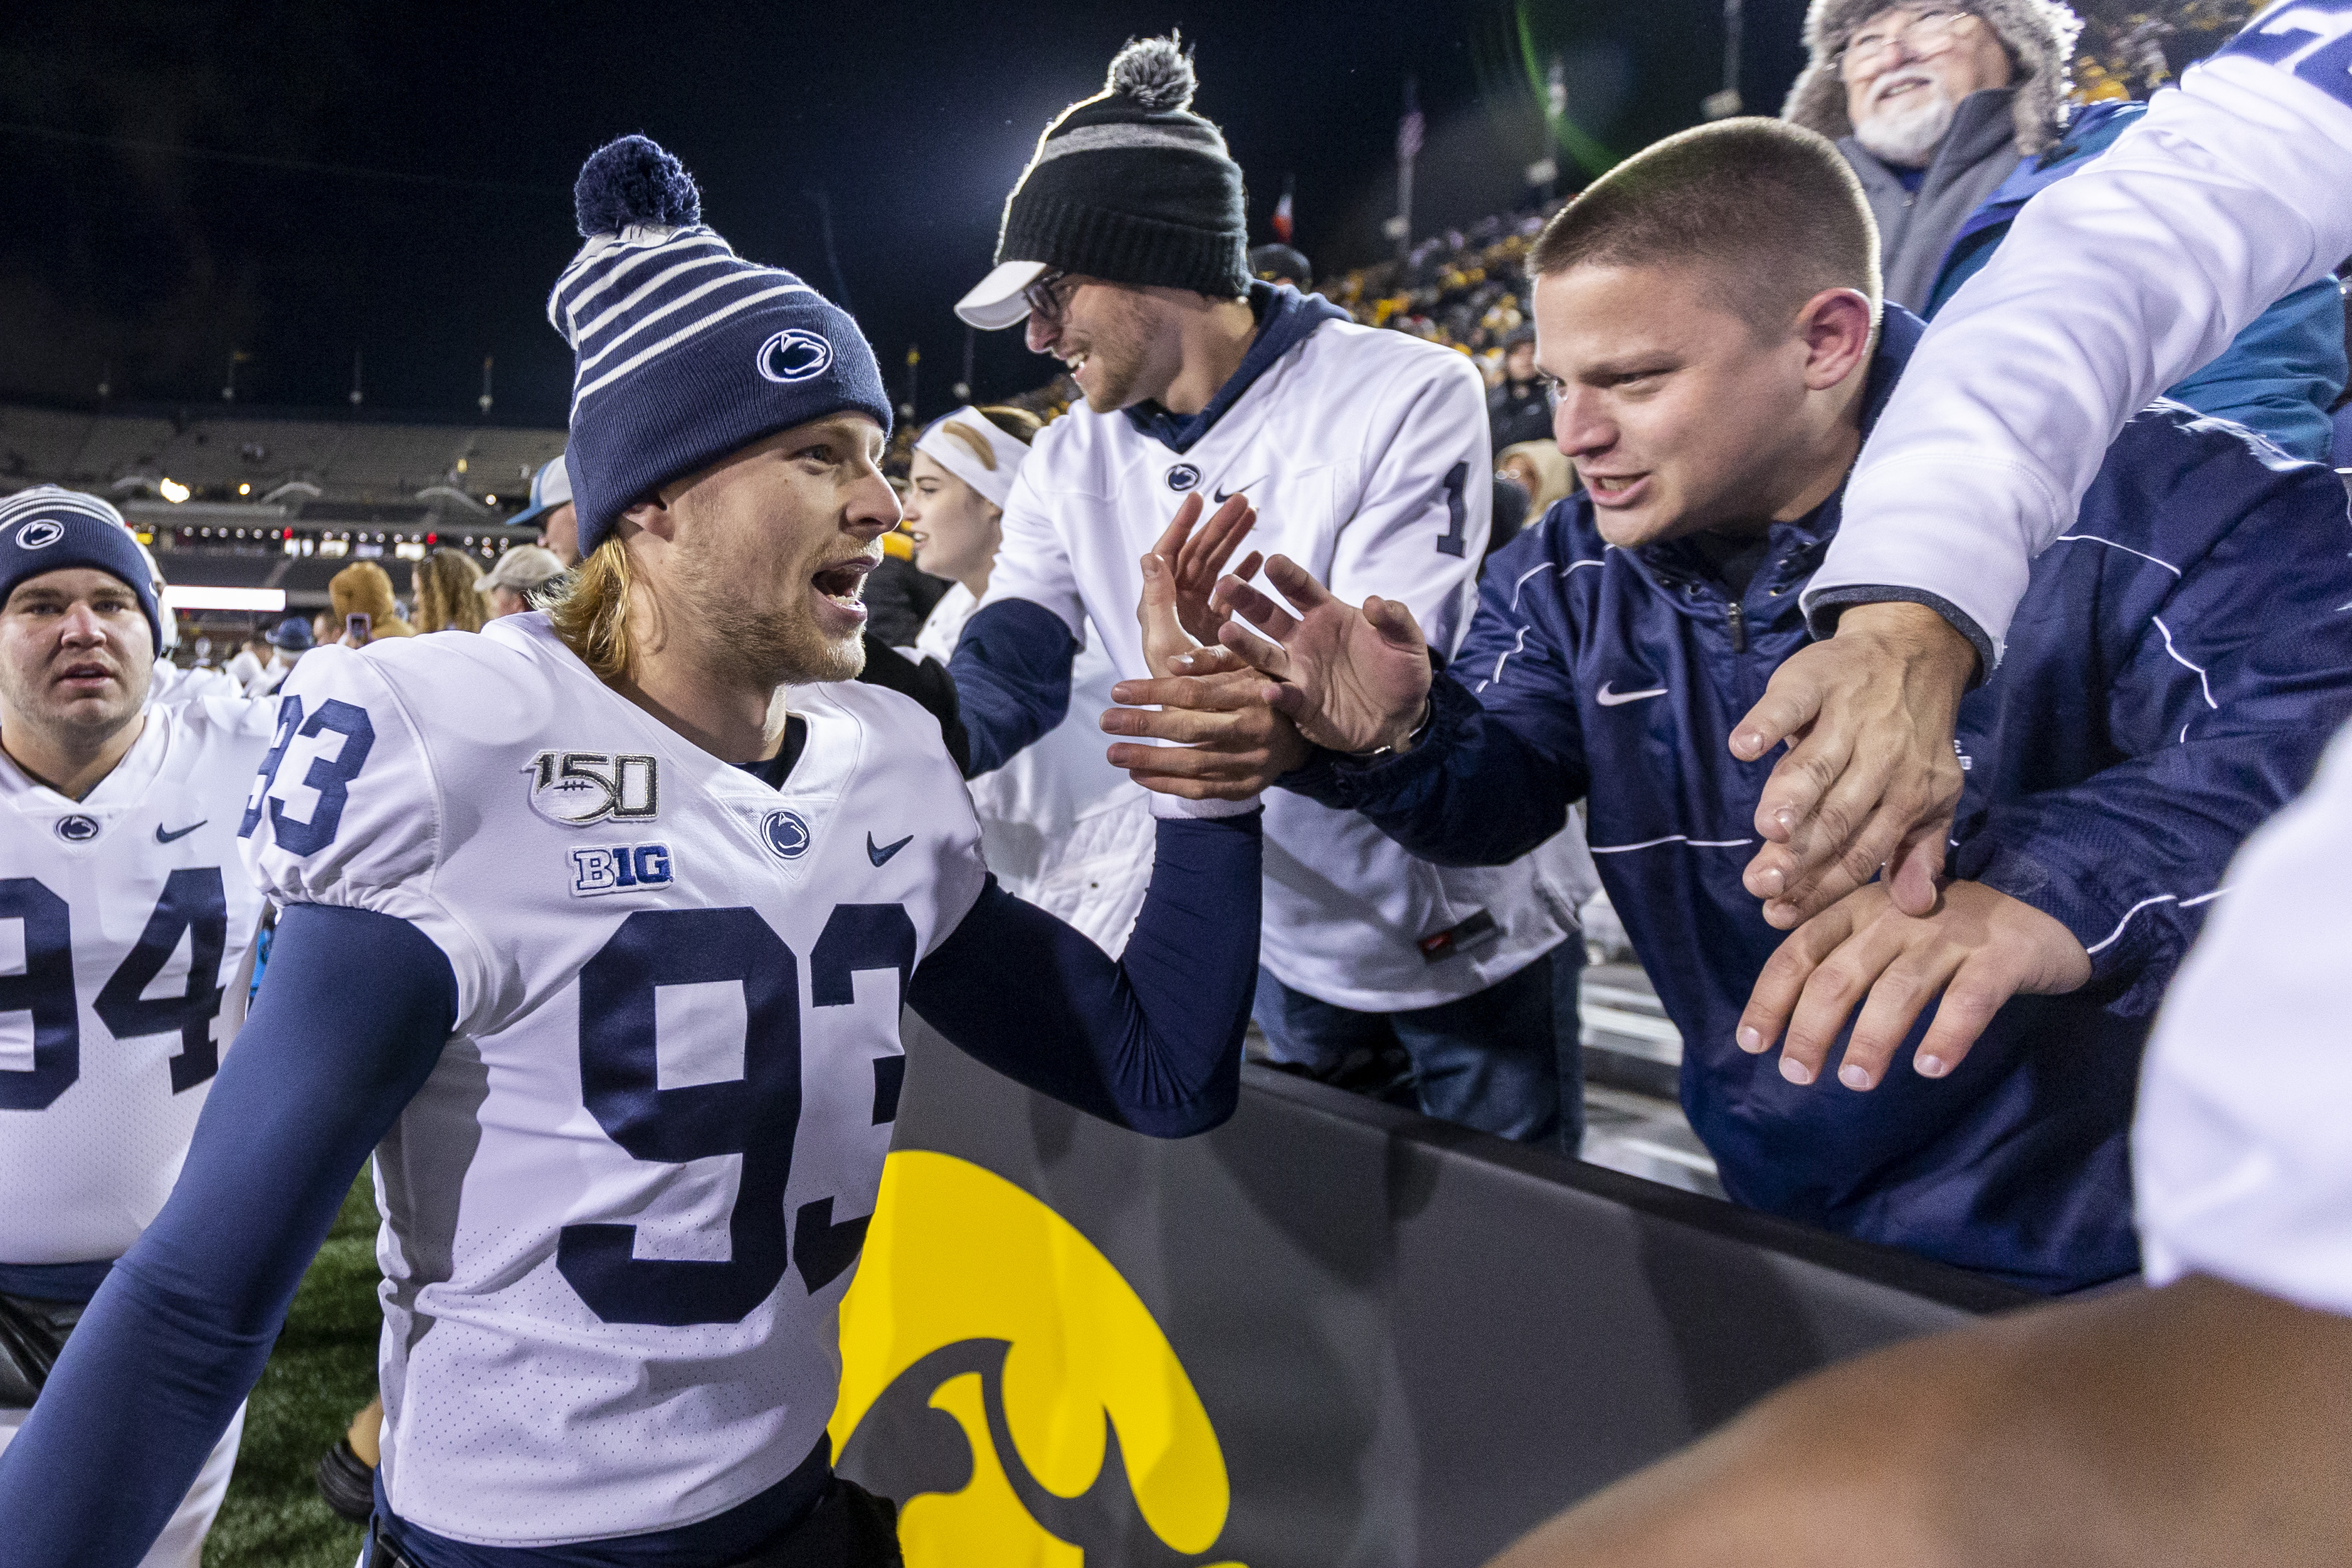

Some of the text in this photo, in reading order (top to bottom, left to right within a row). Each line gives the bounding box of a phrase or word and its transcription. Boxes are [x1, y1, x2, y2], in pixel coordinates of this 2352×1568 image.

[1437, 461, 1469, 559] 1
[534, 752, 658, 822] 150
[556, 903, 918, 1327] 93
